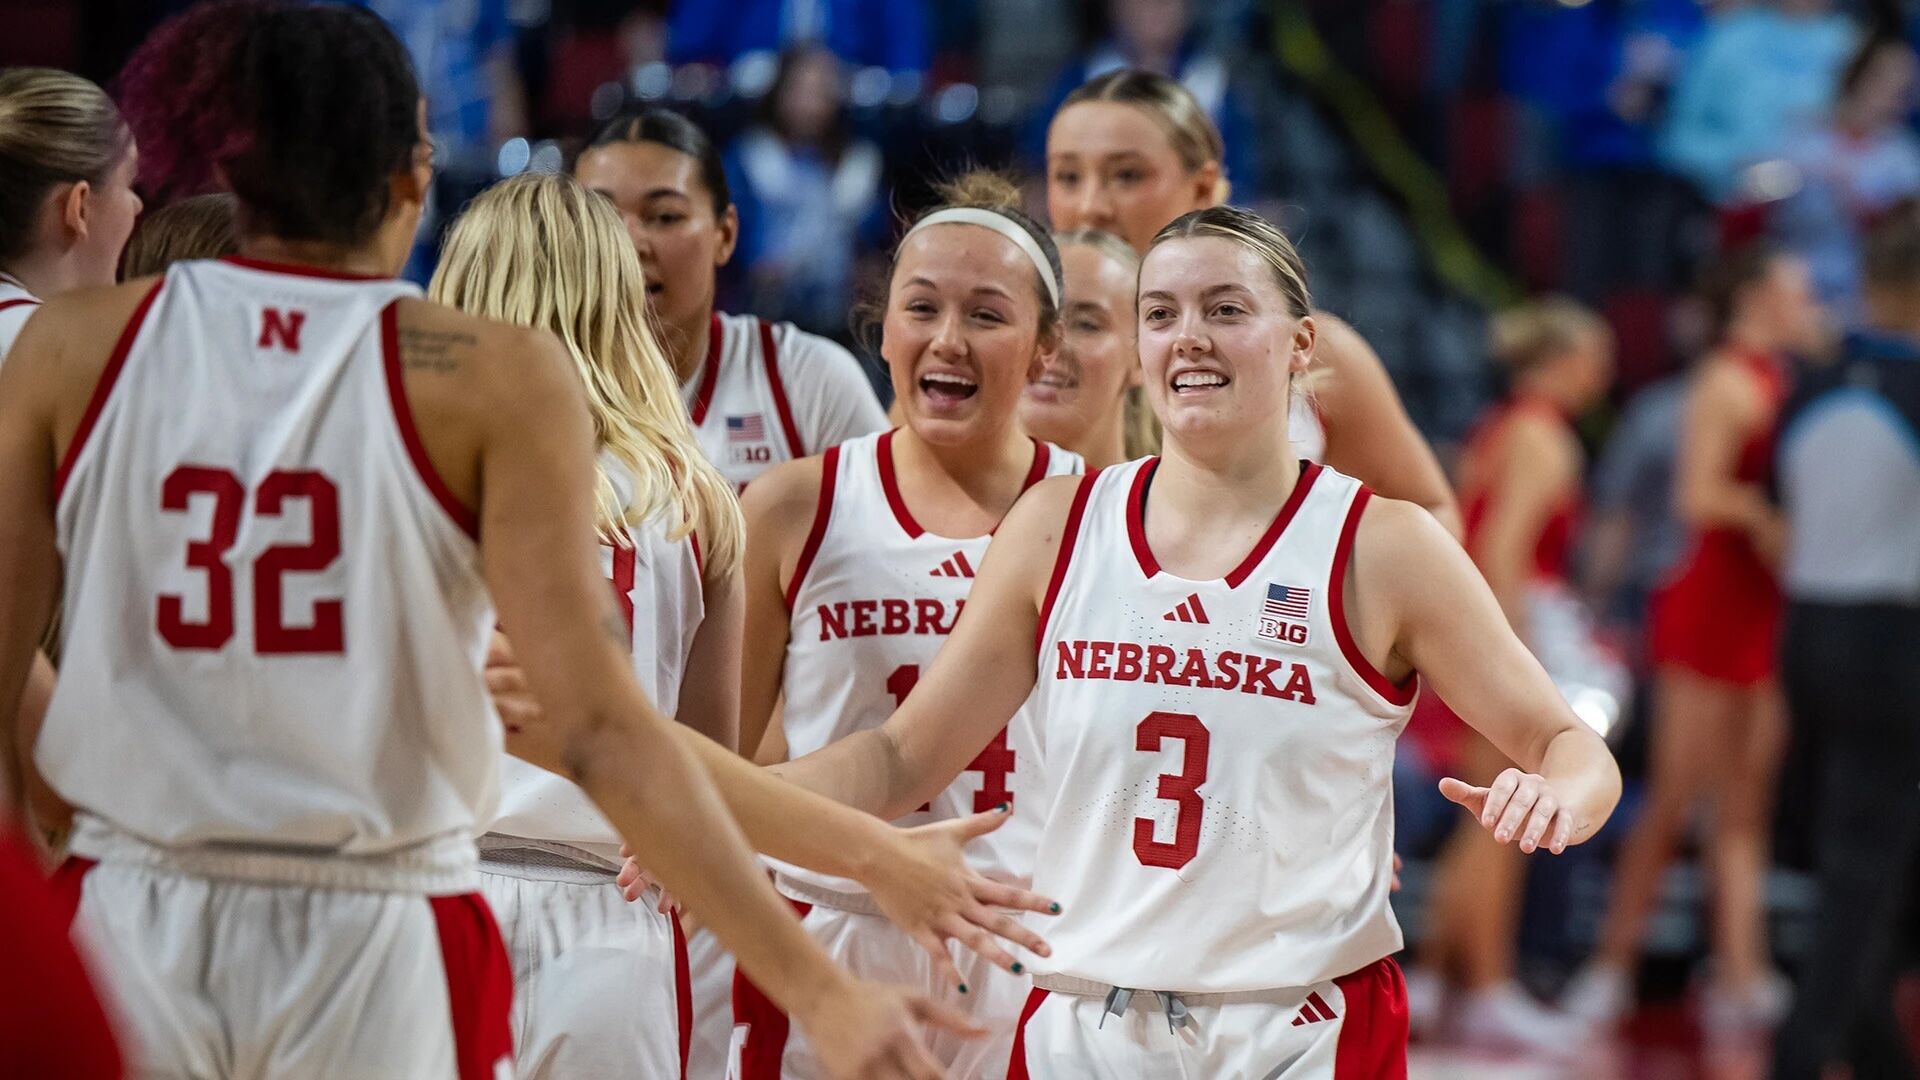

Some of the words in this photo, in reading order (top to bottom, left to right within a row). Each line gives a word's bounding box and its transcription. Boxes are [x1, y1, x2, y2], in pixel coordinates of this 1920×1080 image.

[258, 307, 305, 353] N
[156, 465, 345, 656] 32
[1056, 640, 1317, 706] NEBRASKA
[1133, 711, 1211, 870] 3
